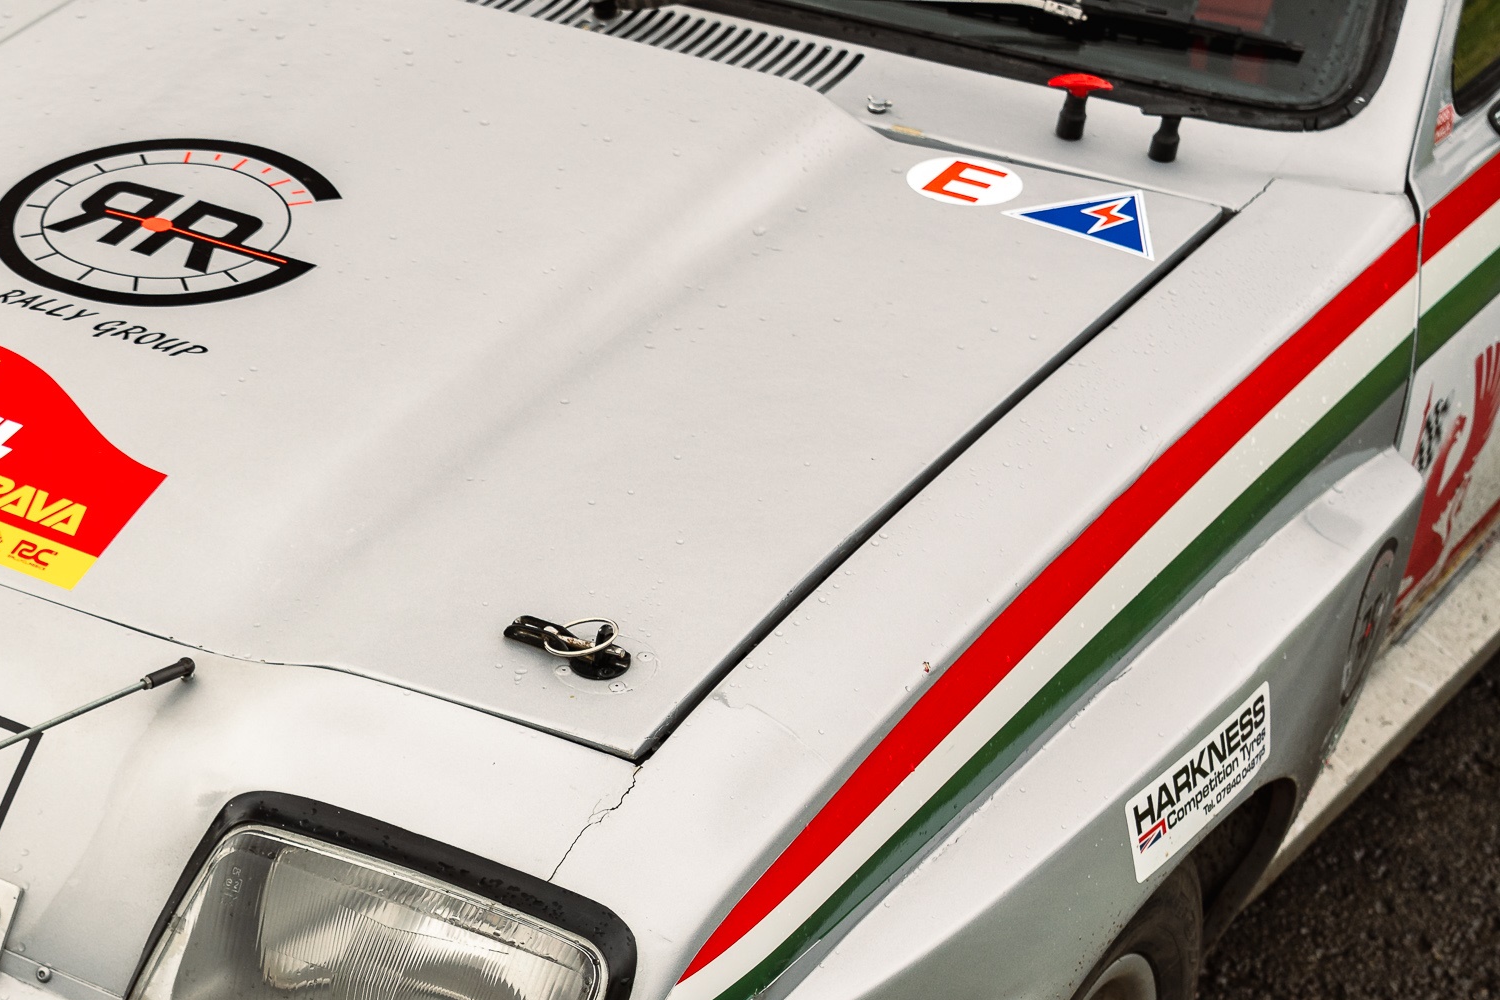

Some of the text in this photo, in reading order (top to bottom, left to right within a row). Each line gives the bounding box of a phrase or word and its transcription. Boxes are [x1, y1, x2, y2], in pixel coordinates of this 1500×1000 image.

[922, 159, 1009, 203] E
[92, 319, 209, 358] GROUP
[1133, 694, 1266, 836] HARKNESS
[1166, 727, 1266, 830] Competition Tyres
